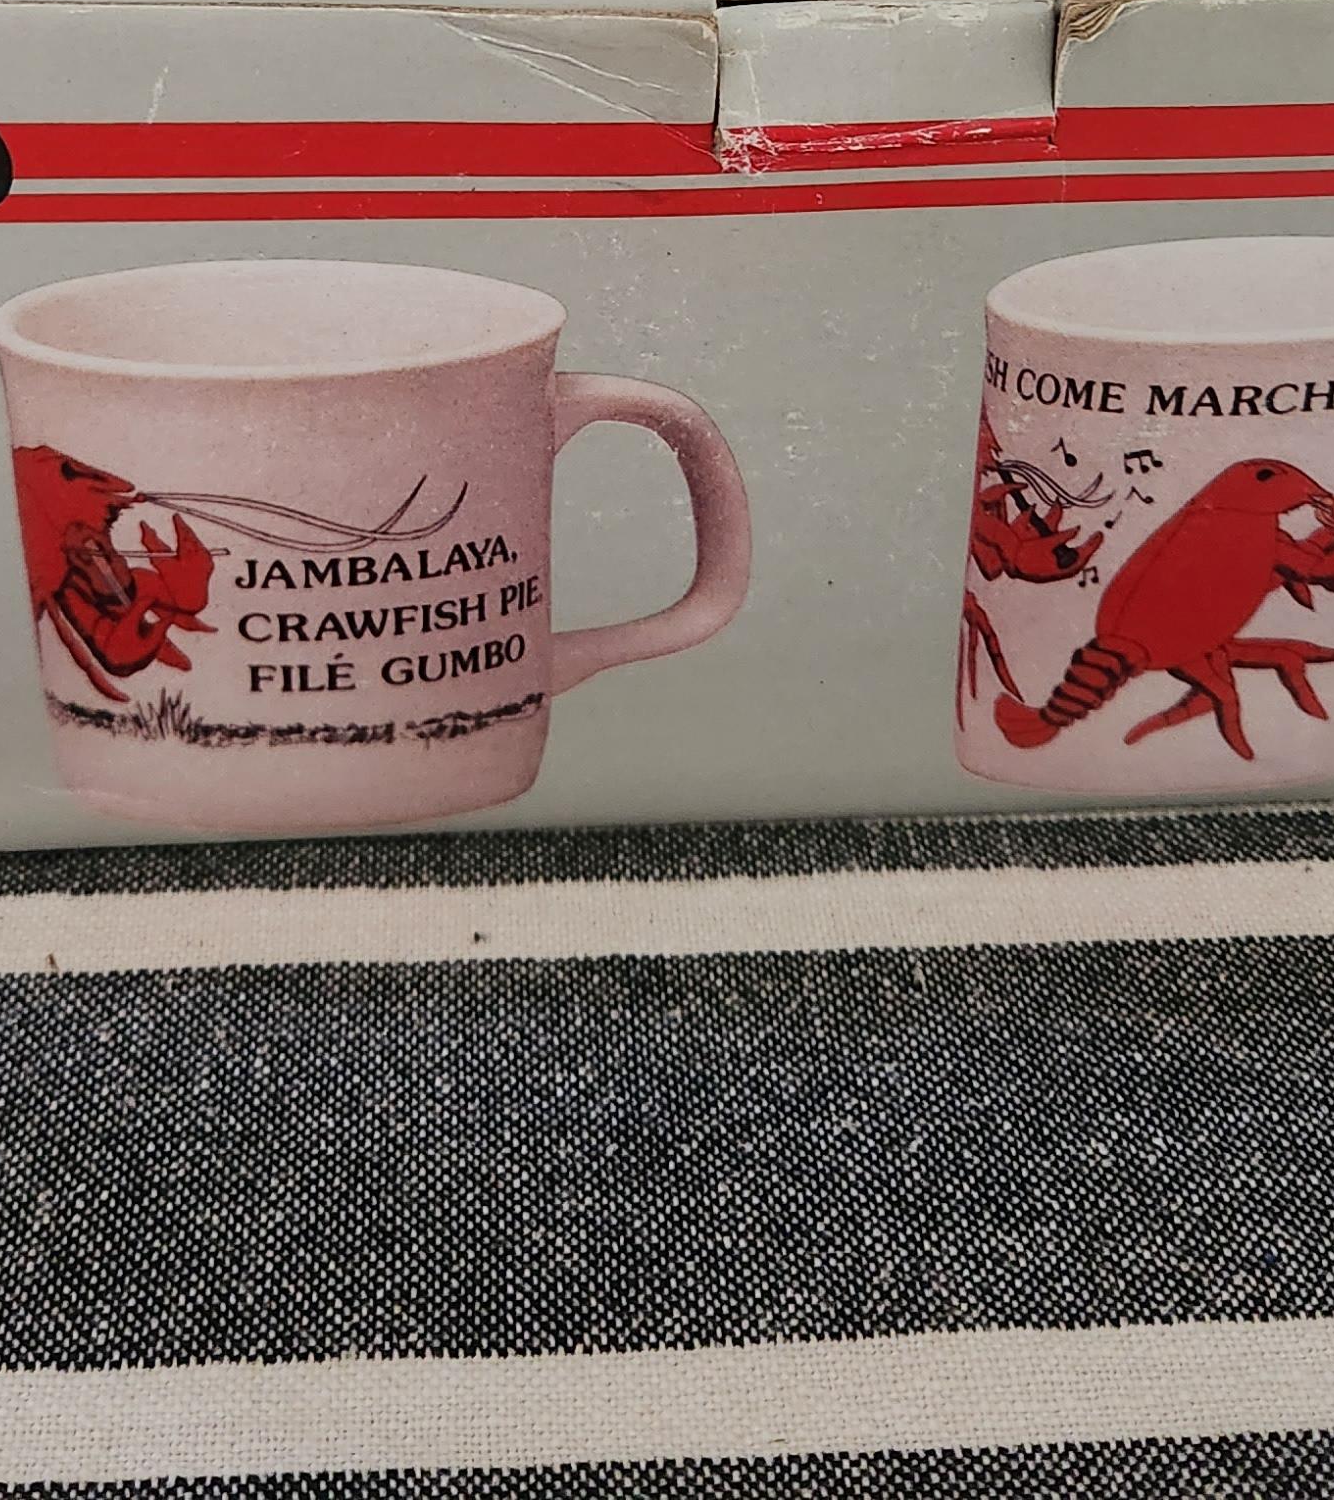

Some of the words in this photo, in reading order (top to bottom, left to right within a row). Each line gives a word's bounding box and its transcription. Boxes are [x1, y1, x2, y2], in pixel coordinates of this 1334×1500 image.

[1017, 368, 1126, 415] COME
[235, 534, 518, 590] JAMBALAYA,
[238, 593, 487, 643] CRAWFISH
[500, 575, 543, 617] PIE
[248, 652, 357, 694] FILÉ
[381, 633, 527, 686] GUMBO
